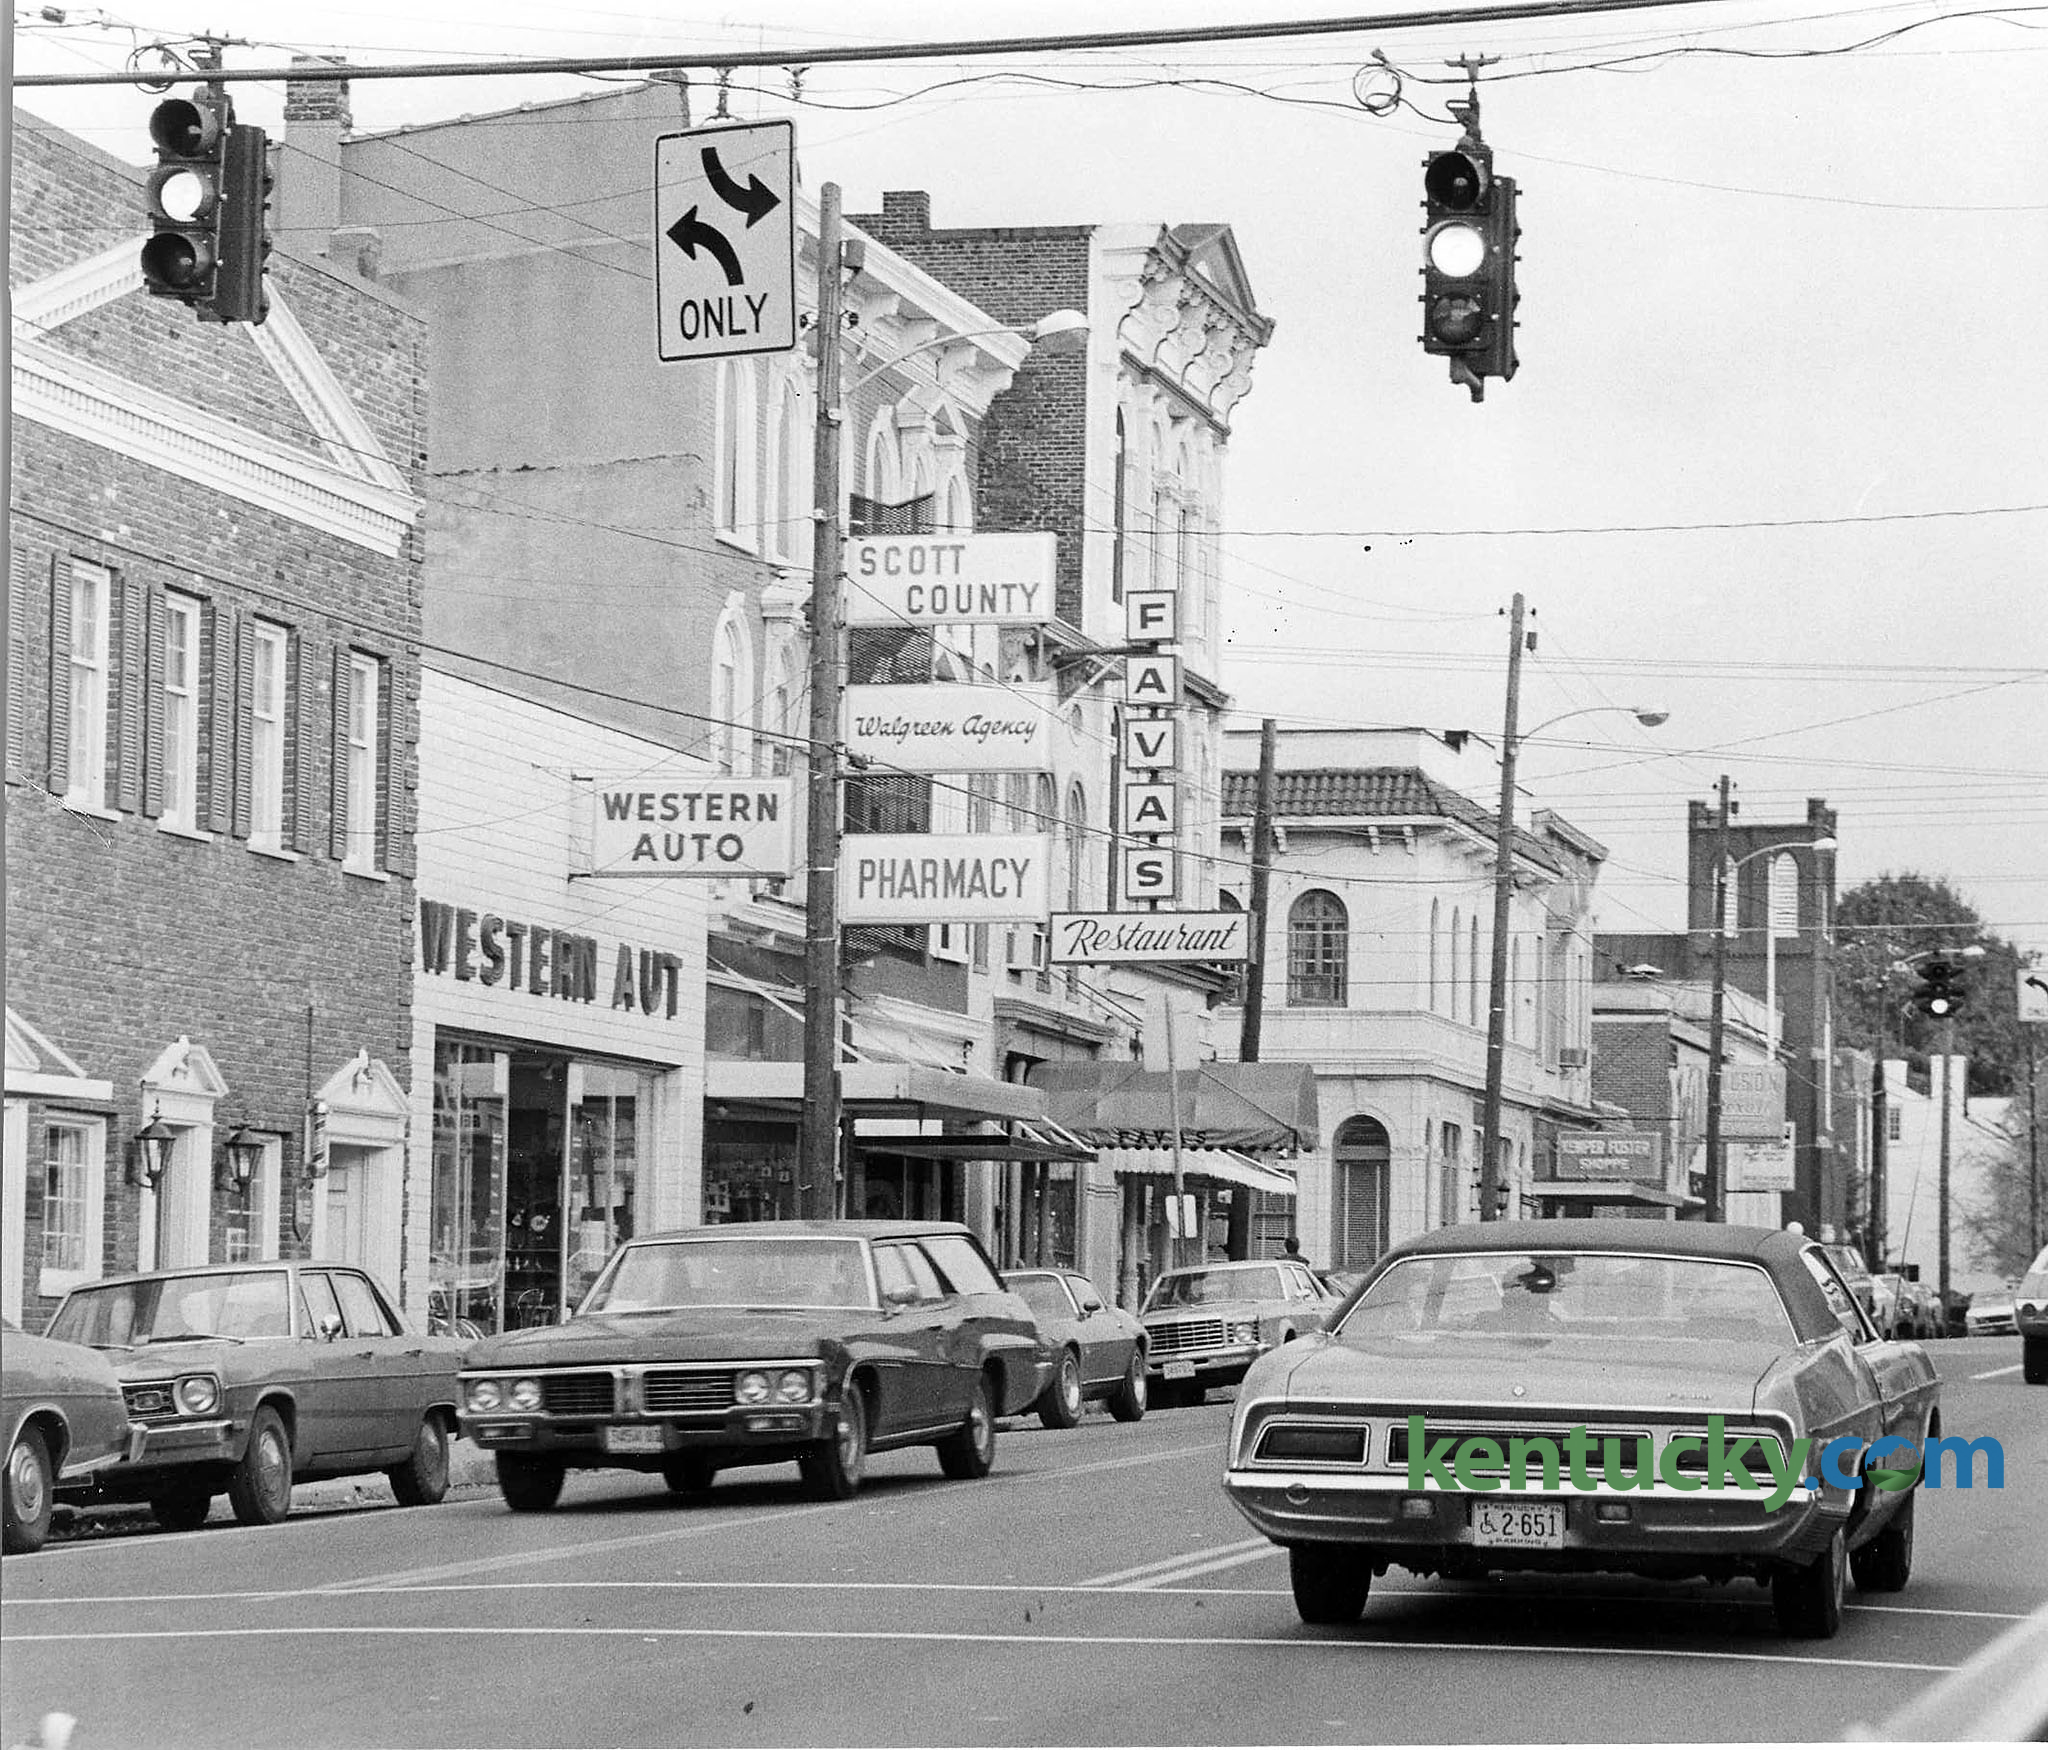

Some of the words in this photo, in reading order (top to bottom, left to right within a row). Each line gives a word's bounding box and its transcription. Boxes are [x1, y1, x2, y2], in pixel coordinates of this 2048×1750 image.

[680, 293, 768, 340] ONLY
[861, 545, 965, 576] SCOTT
[908, 583, 1040, 615] COUNTY
[855, 715, 954, 745] Walgreen
[962, 714, 1037, 744] Agency
[1134, 603, 1168, 887] FAVAS
[603, 792, 778, 821] WESTERN
[632, 833, 744, 862] AUTO
[858, 858, 1030, 899] PHARMACY
[1064, 919, 1238, 956] Restaurant
[420, 897, 598, 1005] WESTERN
[612, 942, 683, 1020] AUT
